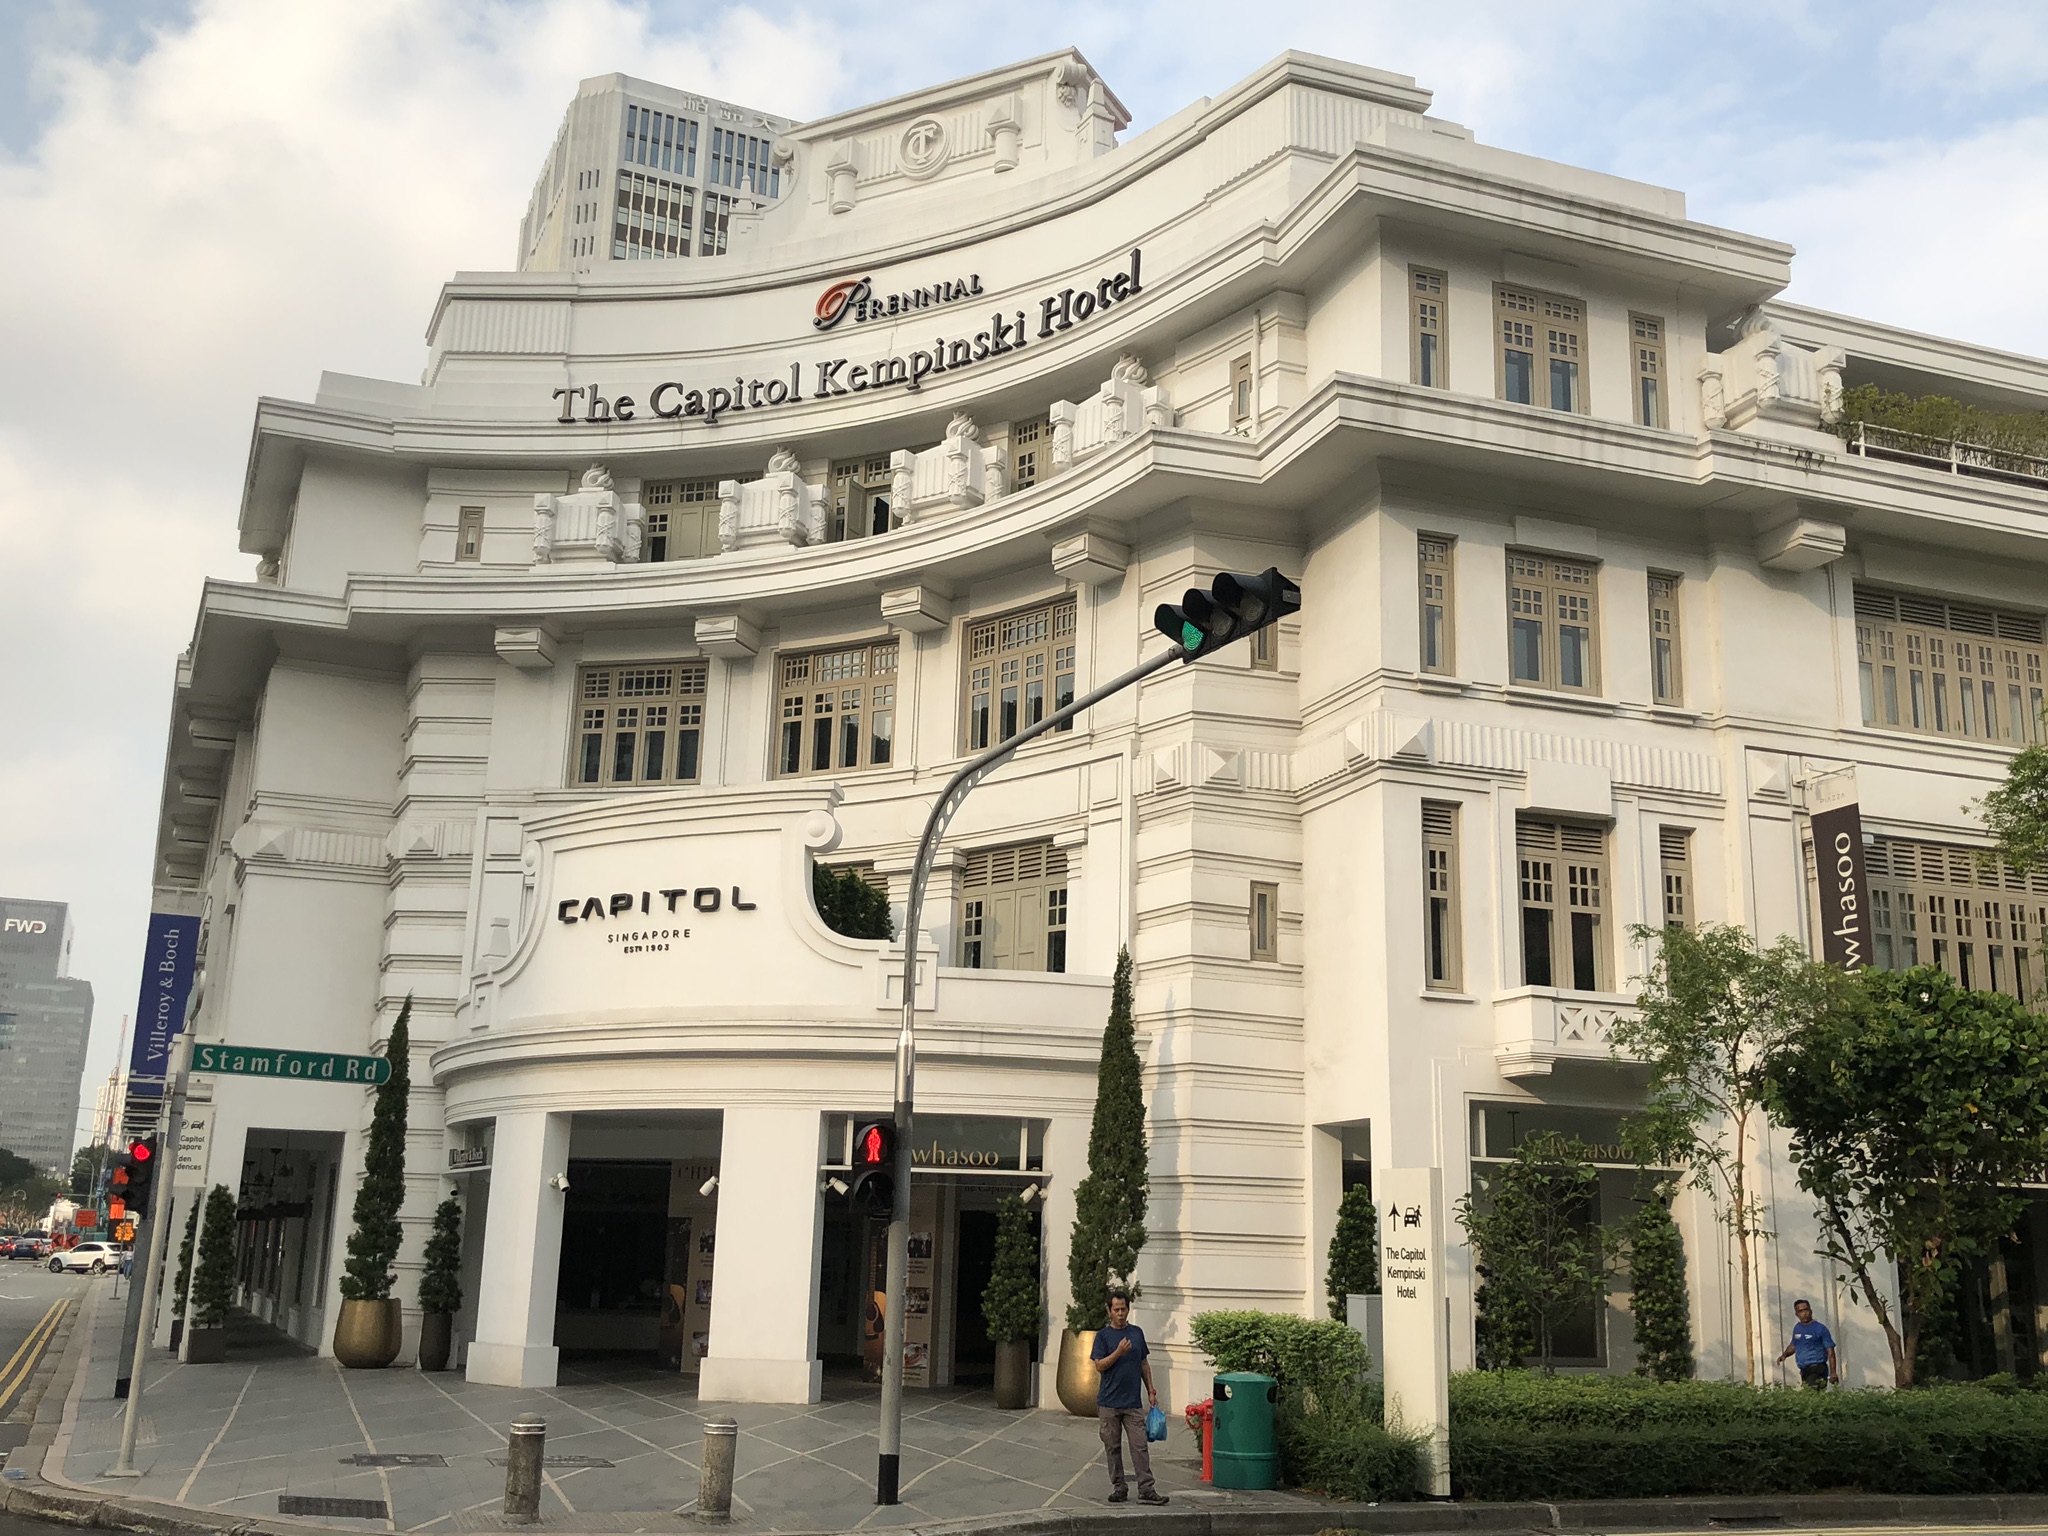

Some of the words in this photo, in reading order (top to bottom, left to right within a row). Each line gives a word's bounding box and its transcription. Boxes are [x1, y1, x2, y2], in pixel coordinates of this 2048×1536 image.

[553, 383, 635, 424] The
[650, 362, 800, 425] Capitol
[815, 309, 1027, 398] Kempinski
[1037, 248, 1143, 338] Hotel
[558, 885, 757, 925] CAPITOL
[4, 918, 47, 934] FWD
[607, 928, 691, 943] SINGAPORE
[158, 928, 181, 973] Boch
[645, 943, 670, 952] 1903
[160, 976, 174, 989] &
[146, 992, 175, 1062] Villeroy
[200, 1047, 334, 1078] Stamford
[345, 1058, 378, 1080] Rd
[180, 1135, 205, 1143] Capitol
[177, 1155, 192, 1163] den
[911, 1139, 1000, 1166] whasoo
[1385, 1246, 1400, 1260] The
[1400, 1247, 1427, 1263] Capitol
[1387, 1266, 1426, 1282] Kempinski
[1396, 1285, 1417, 1299] Hotel
